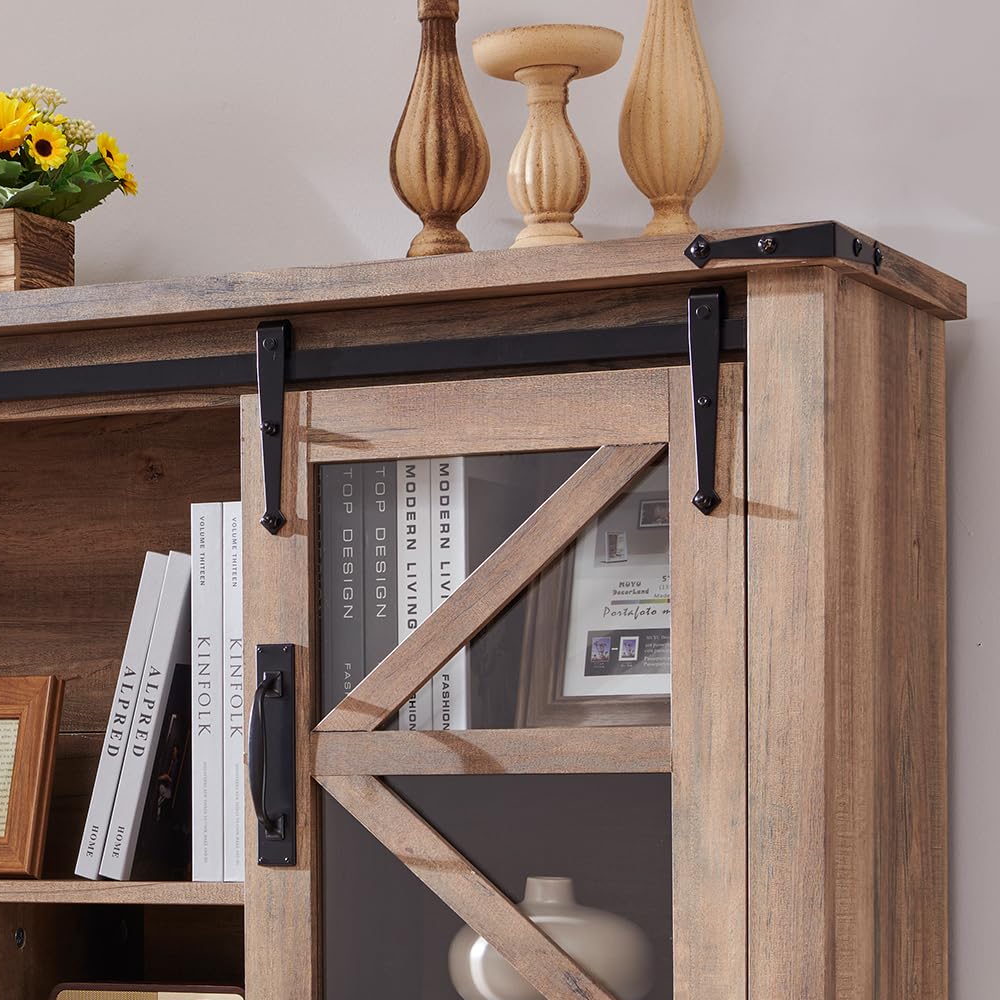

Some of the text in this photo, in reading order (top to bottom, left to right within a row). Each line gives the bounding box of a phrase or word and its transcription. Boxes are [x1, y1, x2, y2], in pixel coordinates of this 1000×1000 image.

[198, 515, 206, 587] VOLUME THITEEN
[342, 467, 354, 620] TOP DESIGN
[375, 466, 387, 618] TOP DESIGN
[405, 464, 418, 629] MODERN LIVING
[439, 463, 451, 599] MODERN LIVI
[107, 665, 137, 758] ALPRED
[132, 665, 161, 758] ALPRED
[197, 635, 212, 736] KINFOLK
[229, 637, 243, 738] KINFOLK
[408, 692, 417, 732] SHION
[442, 673, 450, 731] FASHION
[85, 825, 99, 859] HOME
[111, 825, 126, 860] HOME
